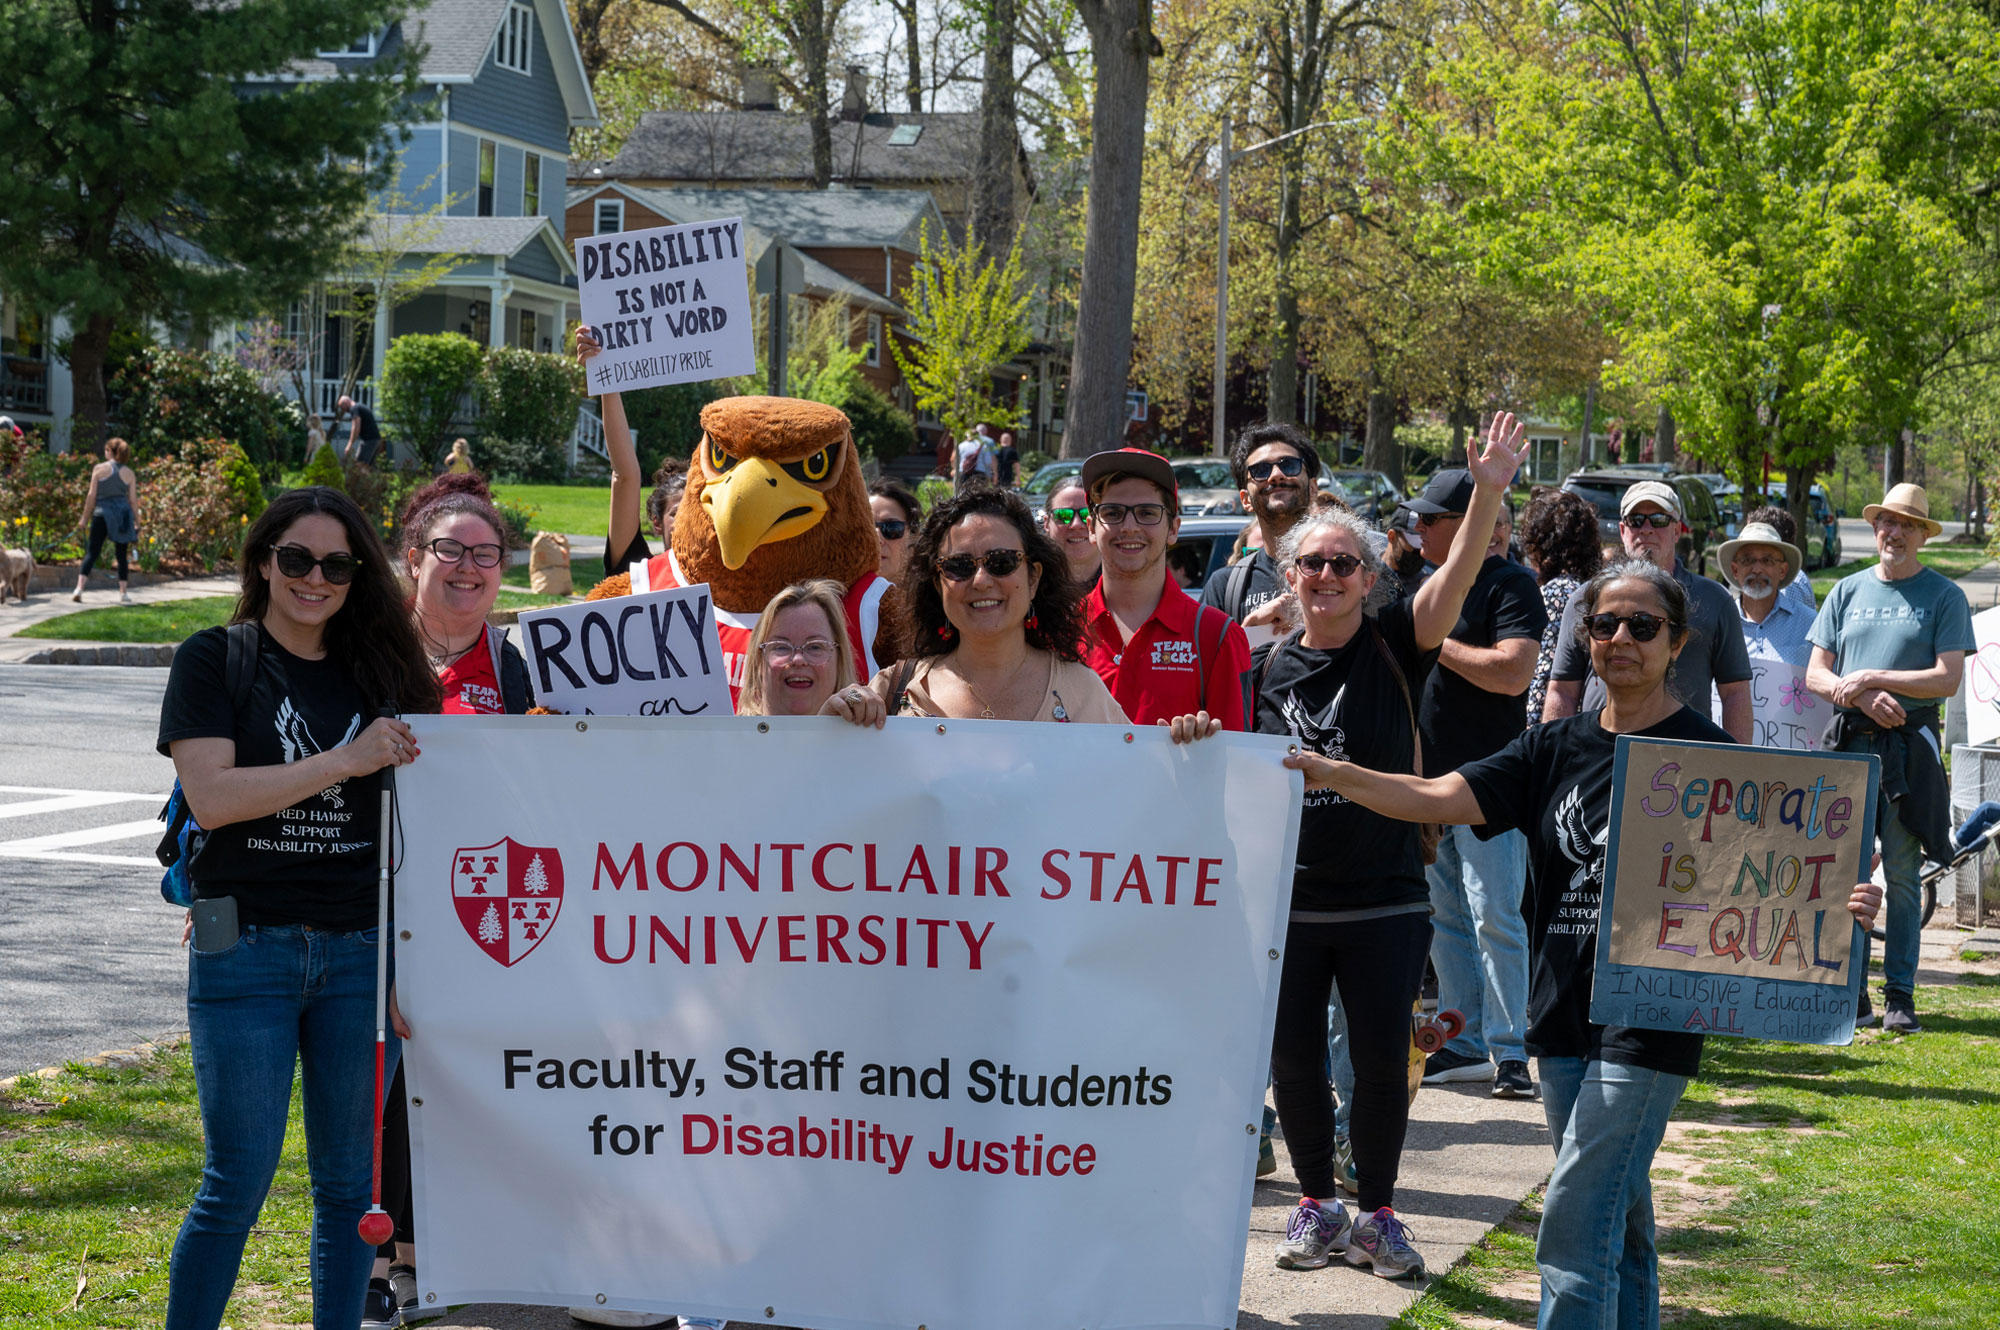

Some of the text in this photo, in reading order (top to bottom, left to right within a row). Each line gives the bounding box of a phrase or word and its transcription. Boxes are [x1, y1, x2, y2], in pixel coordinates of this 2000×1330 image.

[583, 223, 738, 283] DISABILITY
[615, 278, 707, 315] IS NOT A
[590, 306, 728, 350] DIRTY WORD
[527, 594, 711, 694] ROCKY
[1153, 641, 1192, 652] TEAM
[462, 683, 499, 699] TEAM
[639, 697, 709, 717] an
[276, 808, 353, 822] RED HAWKS
[1640, 761, 1853, 843] Separate
[247, 838, 327, 853] DISABILITY
[281, 824, 341, 838] SUPPORT
[591, 842, 1223, 906] MONTCLAIR STATE
[1657, 842, 1836, 902] is NOT
[593, 915, 995, 970] UNIVERSITY
[1656, 901, 1844, 972] EQUAL
[1634, 1002, 1672, 1022] FOR
[1682, 1006, 1744, 1034] ALL
[1754, 981, 1851, 1018] Education
[504, 1047, 1173, 1108] Faculty, Staff and Students
[588, 1114, 1097, 1177] for Disability Justice
